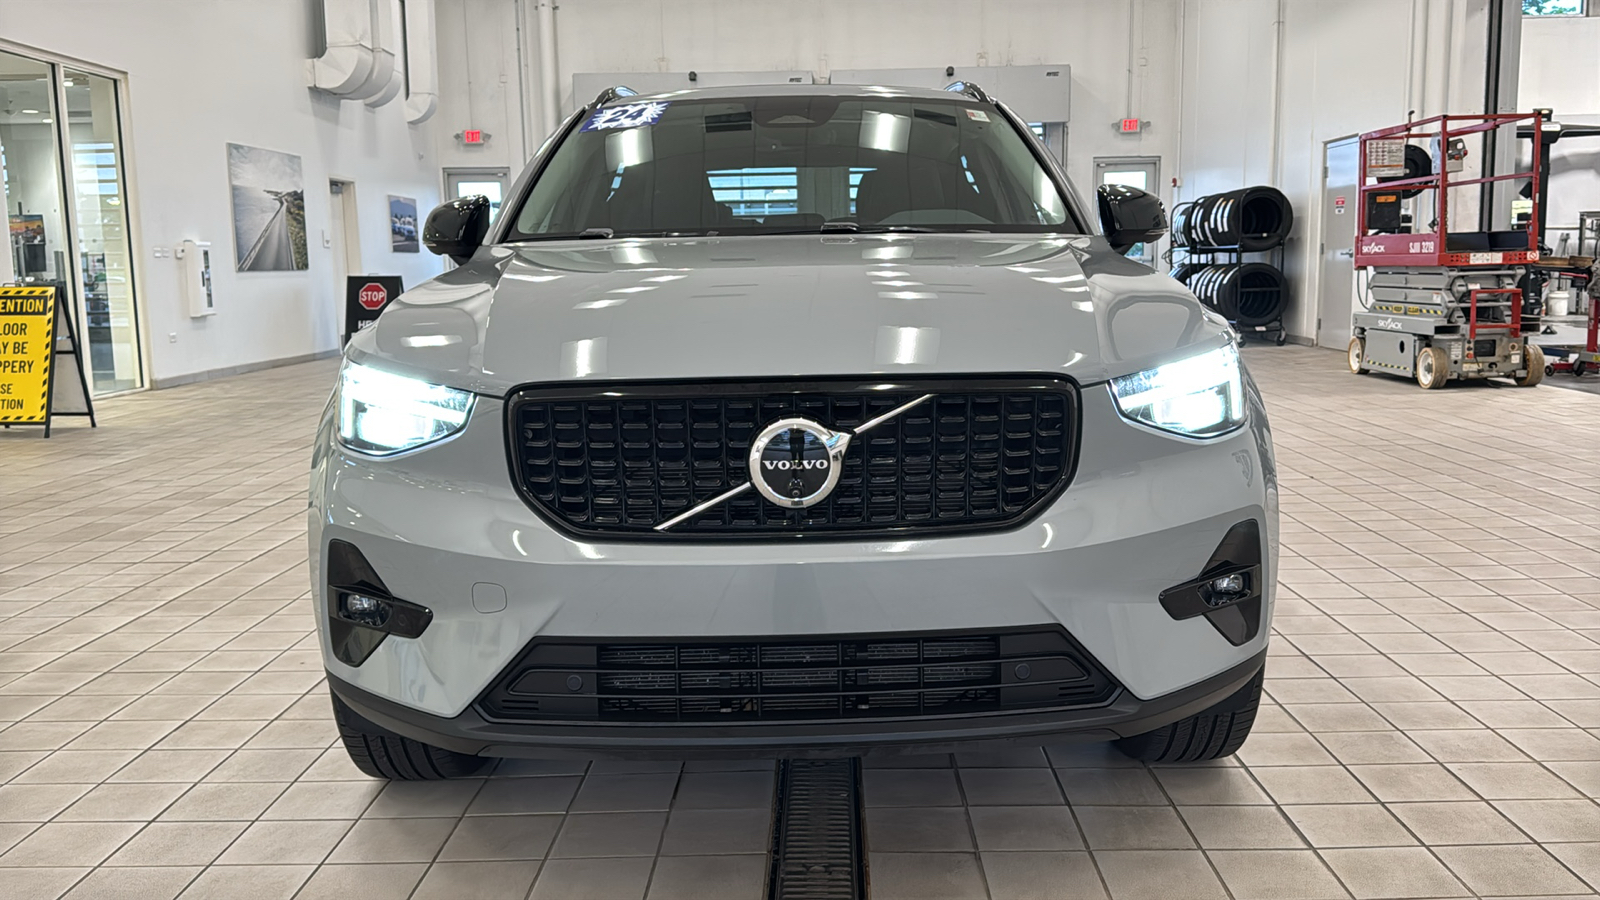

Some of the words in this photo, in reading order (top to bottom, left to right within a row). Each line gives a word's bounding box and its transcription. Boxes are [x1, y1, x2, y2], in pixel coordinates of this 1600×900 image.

[602, 107, 648, 123] 24
[361, 291, 385, 302] STOP
[13, 341, 29, 355] BE
[762, 459, 829, 470] VOLVO
